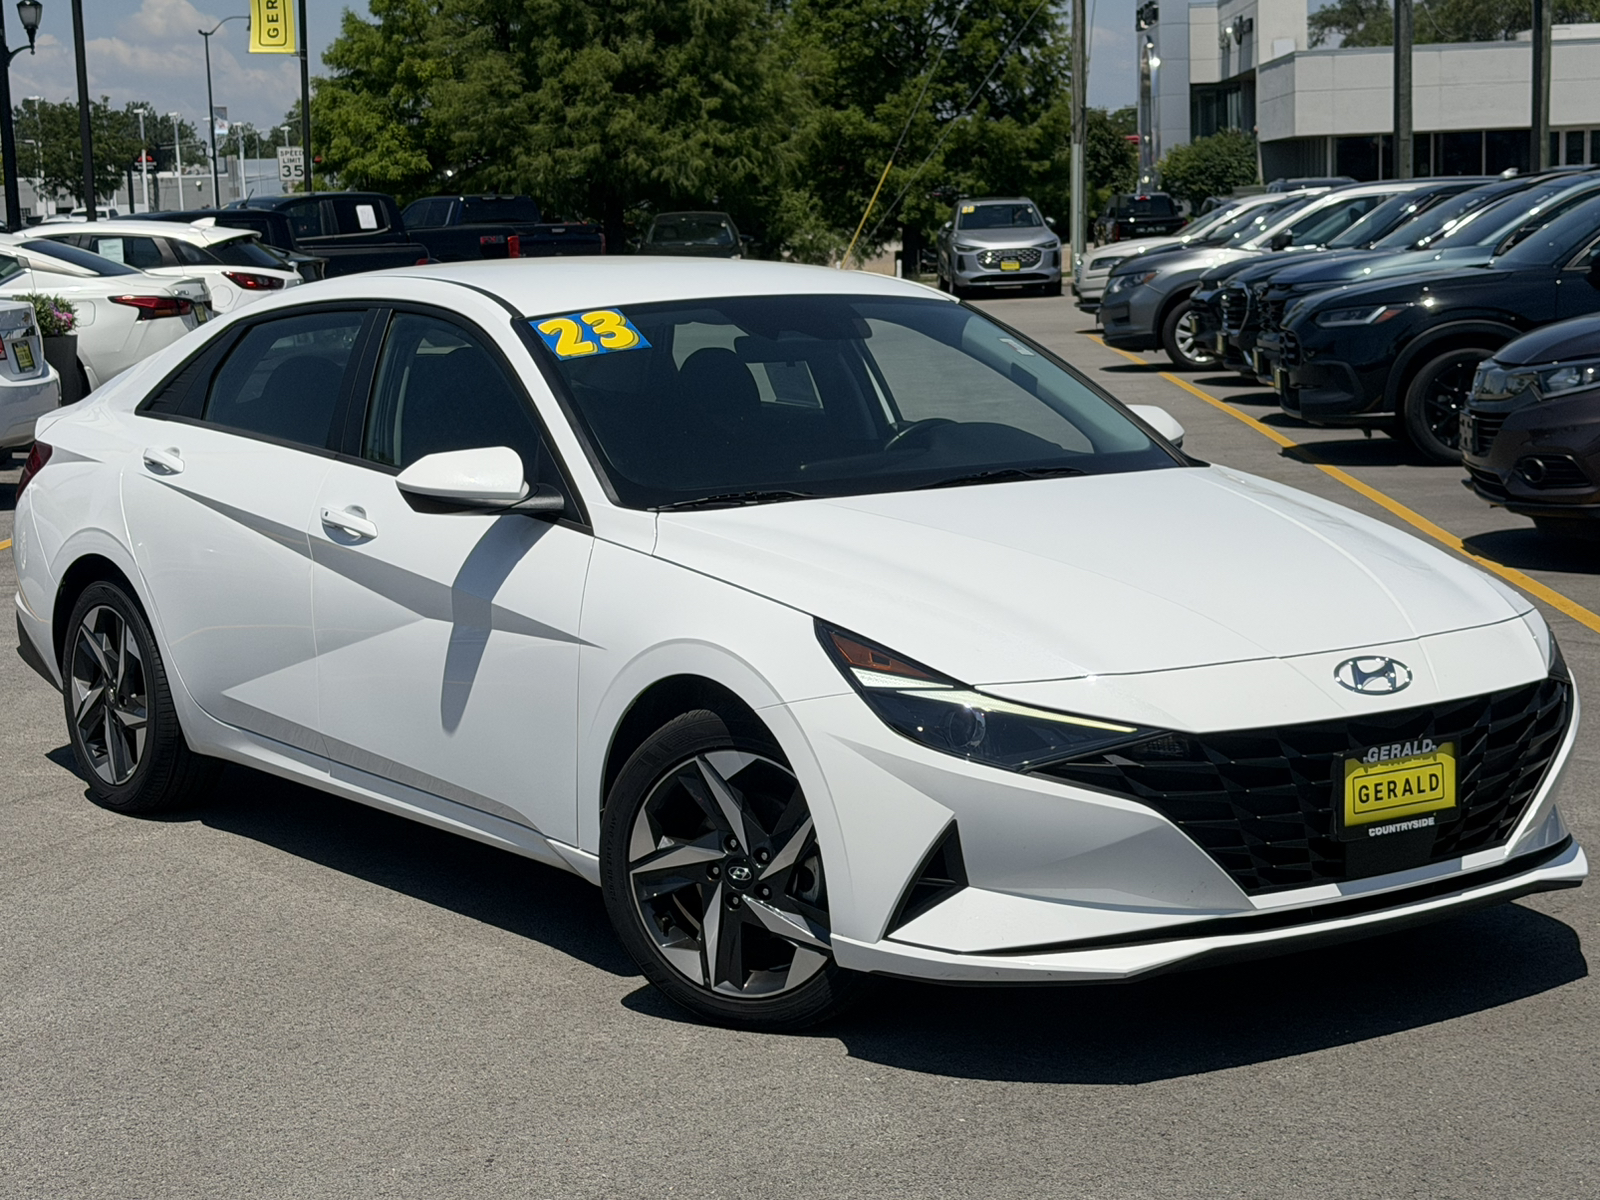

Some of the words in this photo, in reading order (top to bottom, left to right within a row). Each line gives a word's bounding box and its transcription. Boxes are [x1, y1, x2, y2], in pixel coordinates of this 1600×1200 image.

[282, 165, 304, 177] 35
[537, 310, 640, 357] 23
[1367, 739, 1433, 763] GERALD
[1358, 773, 1440, 804] GERALD
[1368, 817, 1435, 837] COUNTRYSIDE
